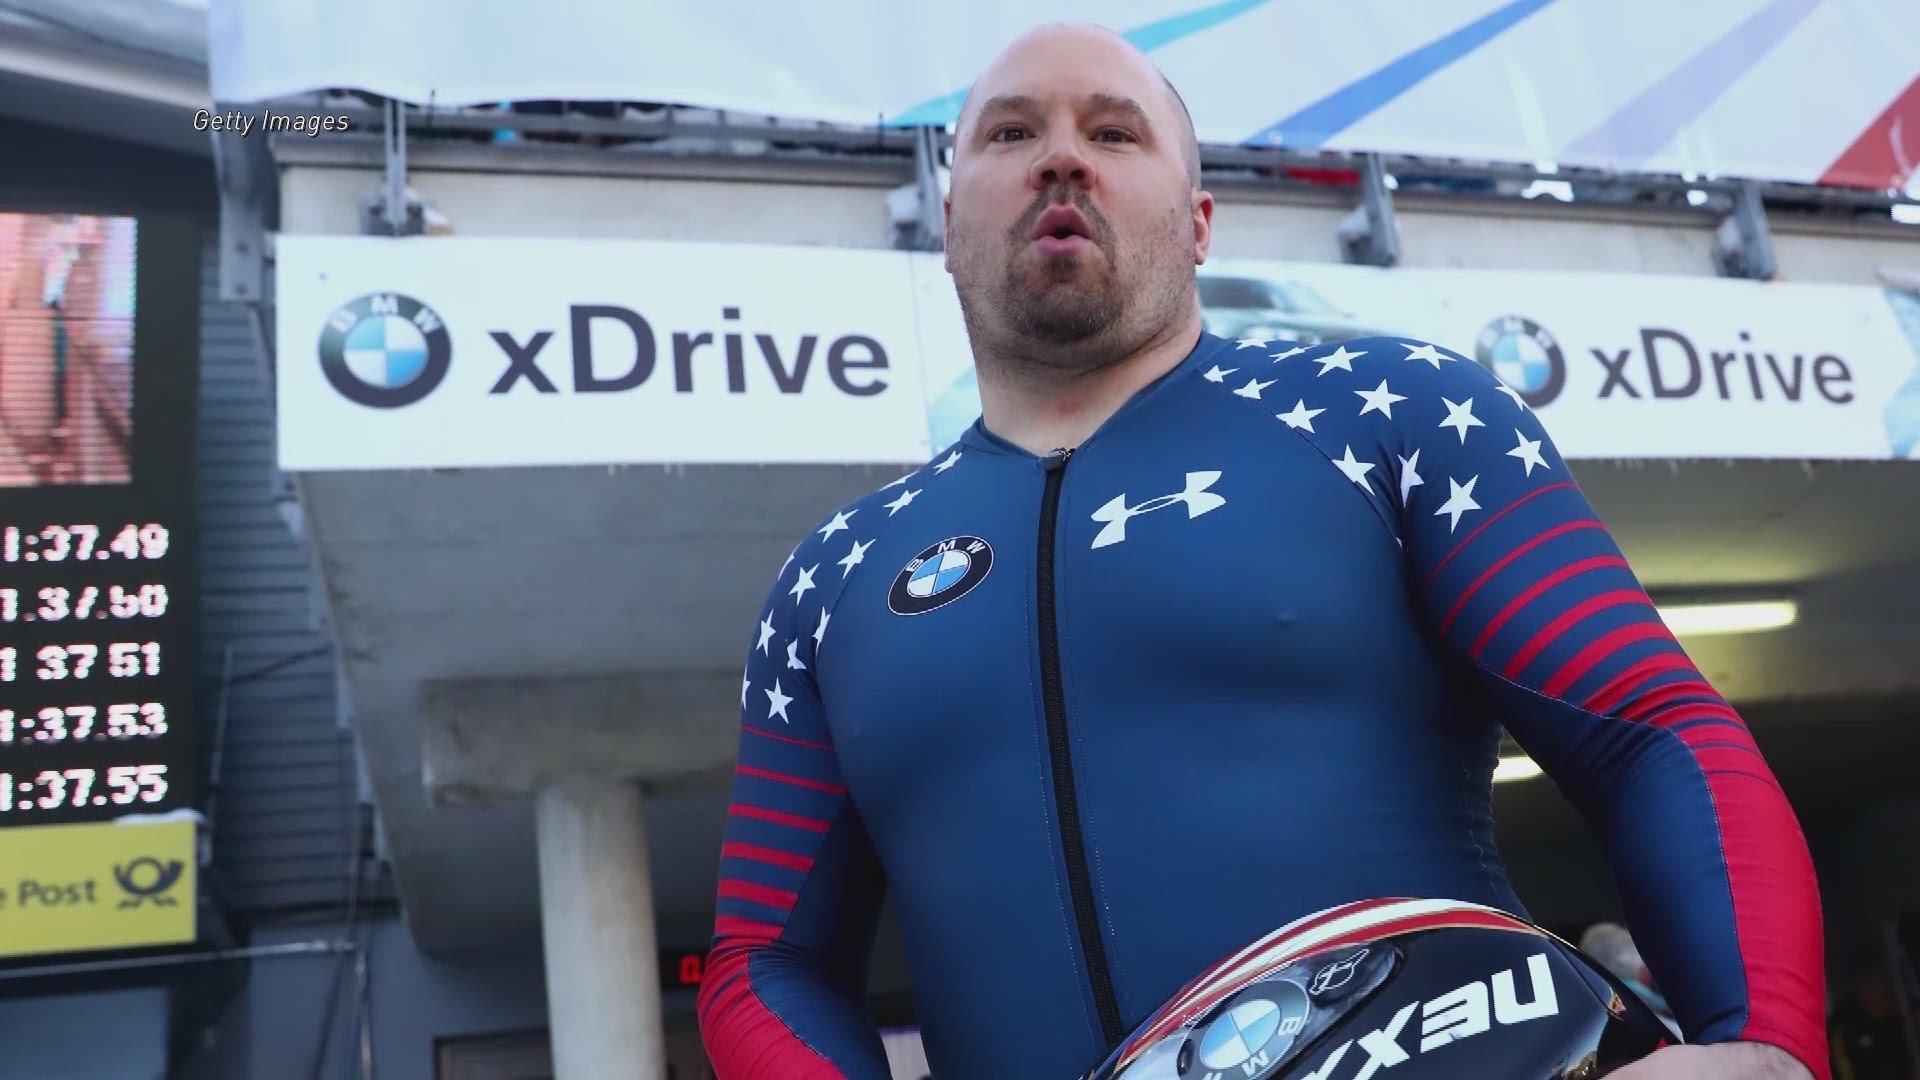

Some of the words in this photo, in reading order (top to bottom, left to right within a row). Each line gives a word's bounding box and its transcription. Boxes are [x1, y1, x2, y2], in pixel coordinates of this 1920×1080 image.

[329, 294, 441, 334] BMW
[488, 303, 891, 398] xDrive
[1588, 326, 1855, 405] xDrive
[3, 523, 170, 562] 1:37.49
[905, 539, 986, 573] BMW
[0, 764, 169, 812] 1:37.55
[17, 878, 96, 909] Post
